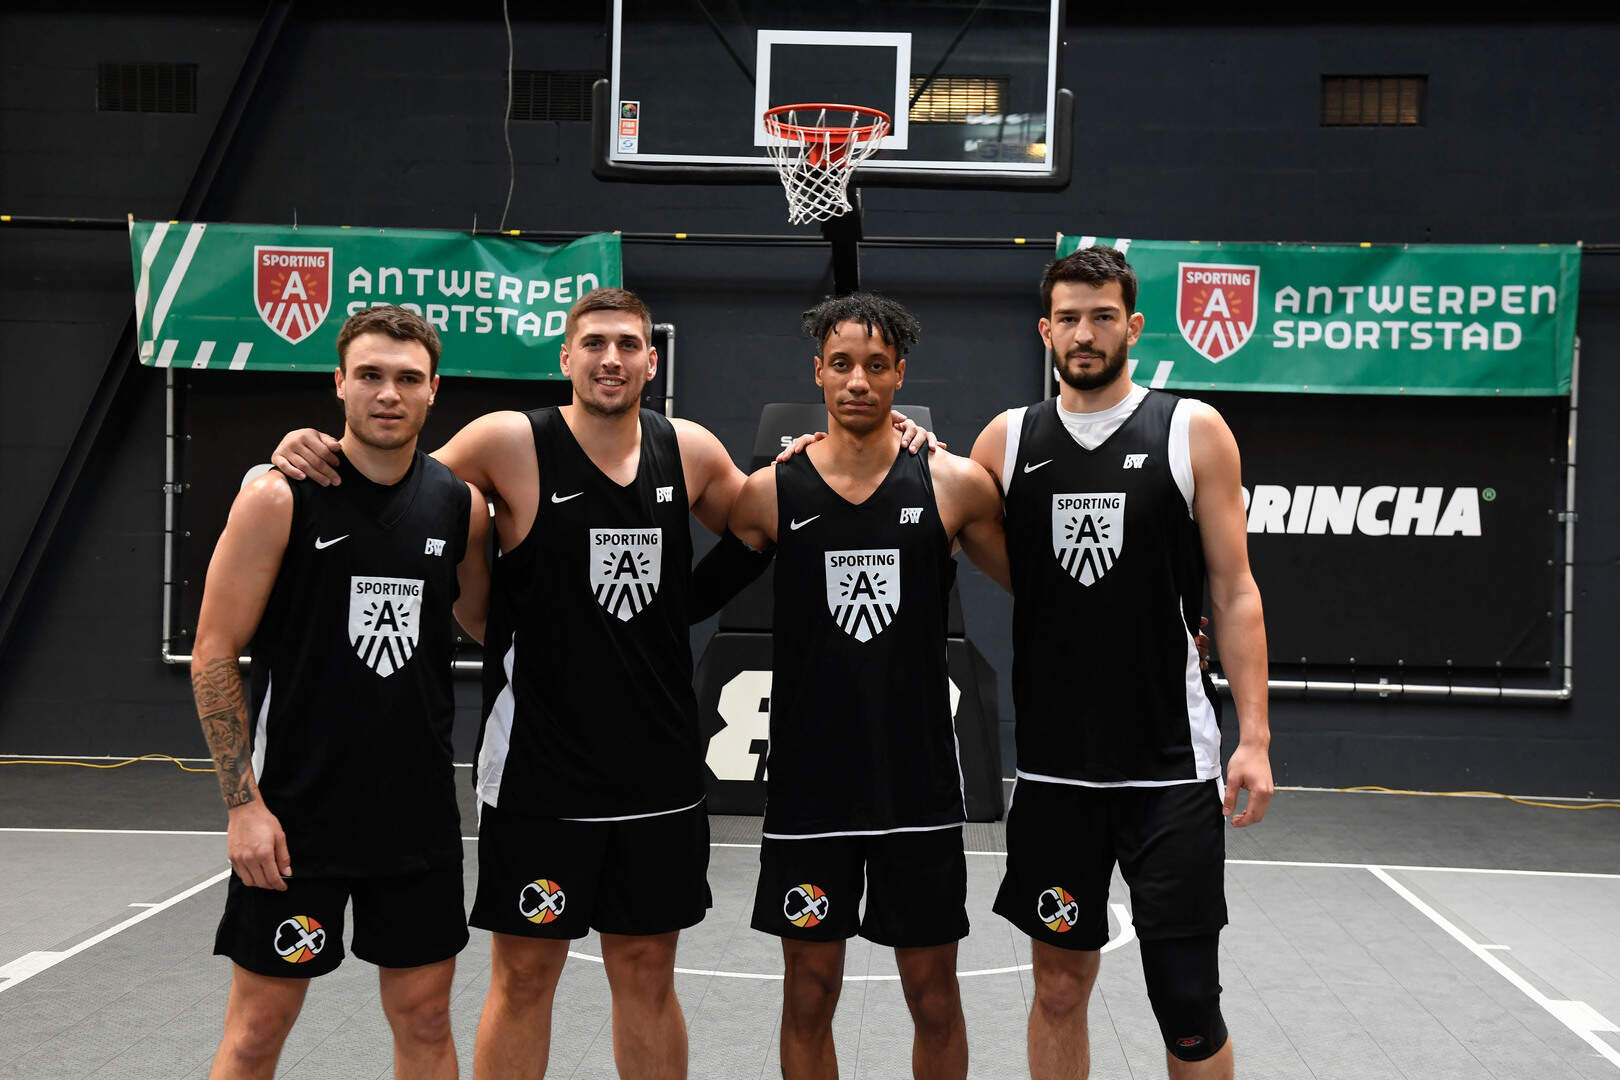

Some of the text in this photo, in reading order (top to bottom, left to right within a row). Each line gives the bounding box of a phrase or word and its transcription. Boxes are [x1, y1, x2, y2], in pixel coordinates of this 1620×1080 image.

[262, 254, 326, 268] SPORTING
[348, 265, 600, 305] ANTWERPEN
[1186, 271, 1251, 286] SPORTING
[1274, 285, 1557, 315] ANTWERPEN
[346, 300, 568, 337] SRTSTAD
[1272, 320, 1523, 351] SPORTSTAD
[1057, 497, 1121, 511] SPORTING
[1241, 484, 1482, 537] RINCHA
[595, 533, 658, 546] SPORTING
[830, 554, 895, 568] SPORTING
[356, 581, 420, 597] SPORTING
